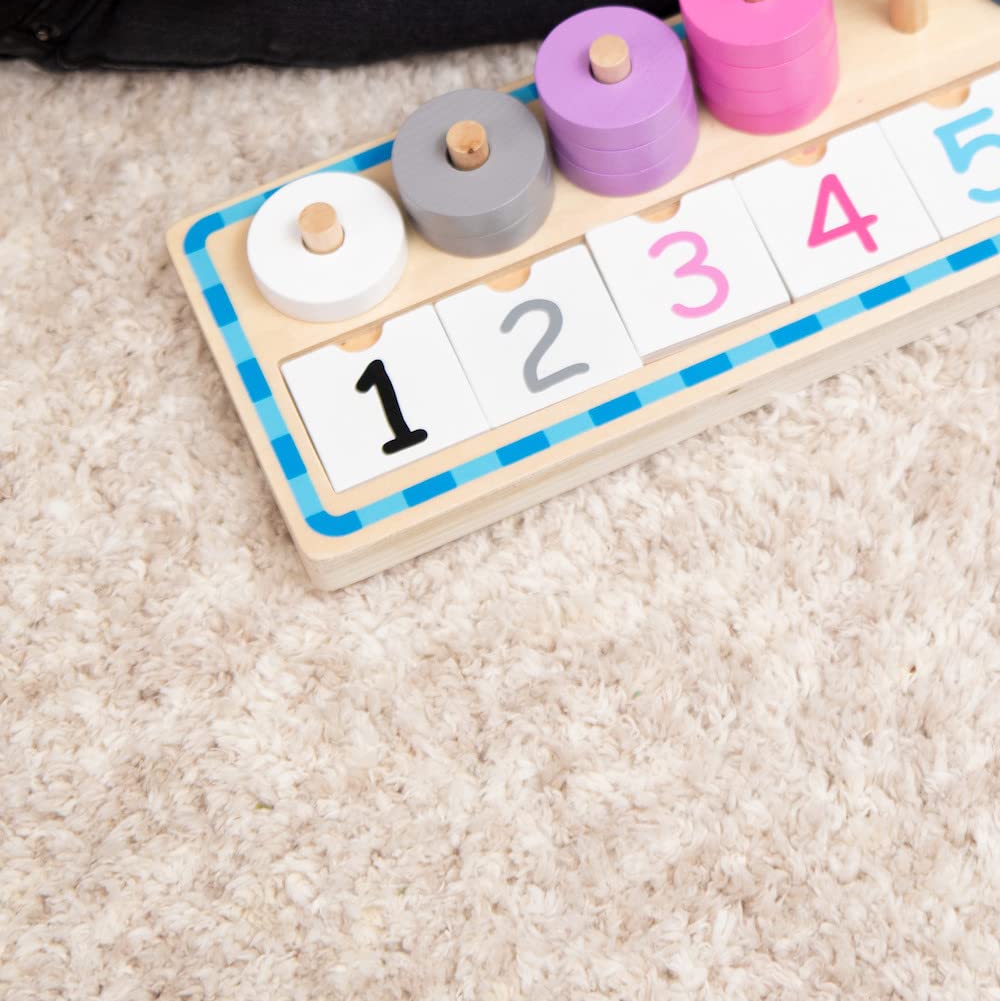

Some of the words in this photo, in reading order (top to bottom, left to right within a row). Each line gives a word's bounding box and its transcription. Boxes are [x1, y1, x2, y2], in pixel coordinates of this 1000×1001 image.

[807, 173, 879, 253] 4
[649, 231, 729, 318] 3
[500, 299, 590, 393] 2
[355, 359, 428, 456] 1
